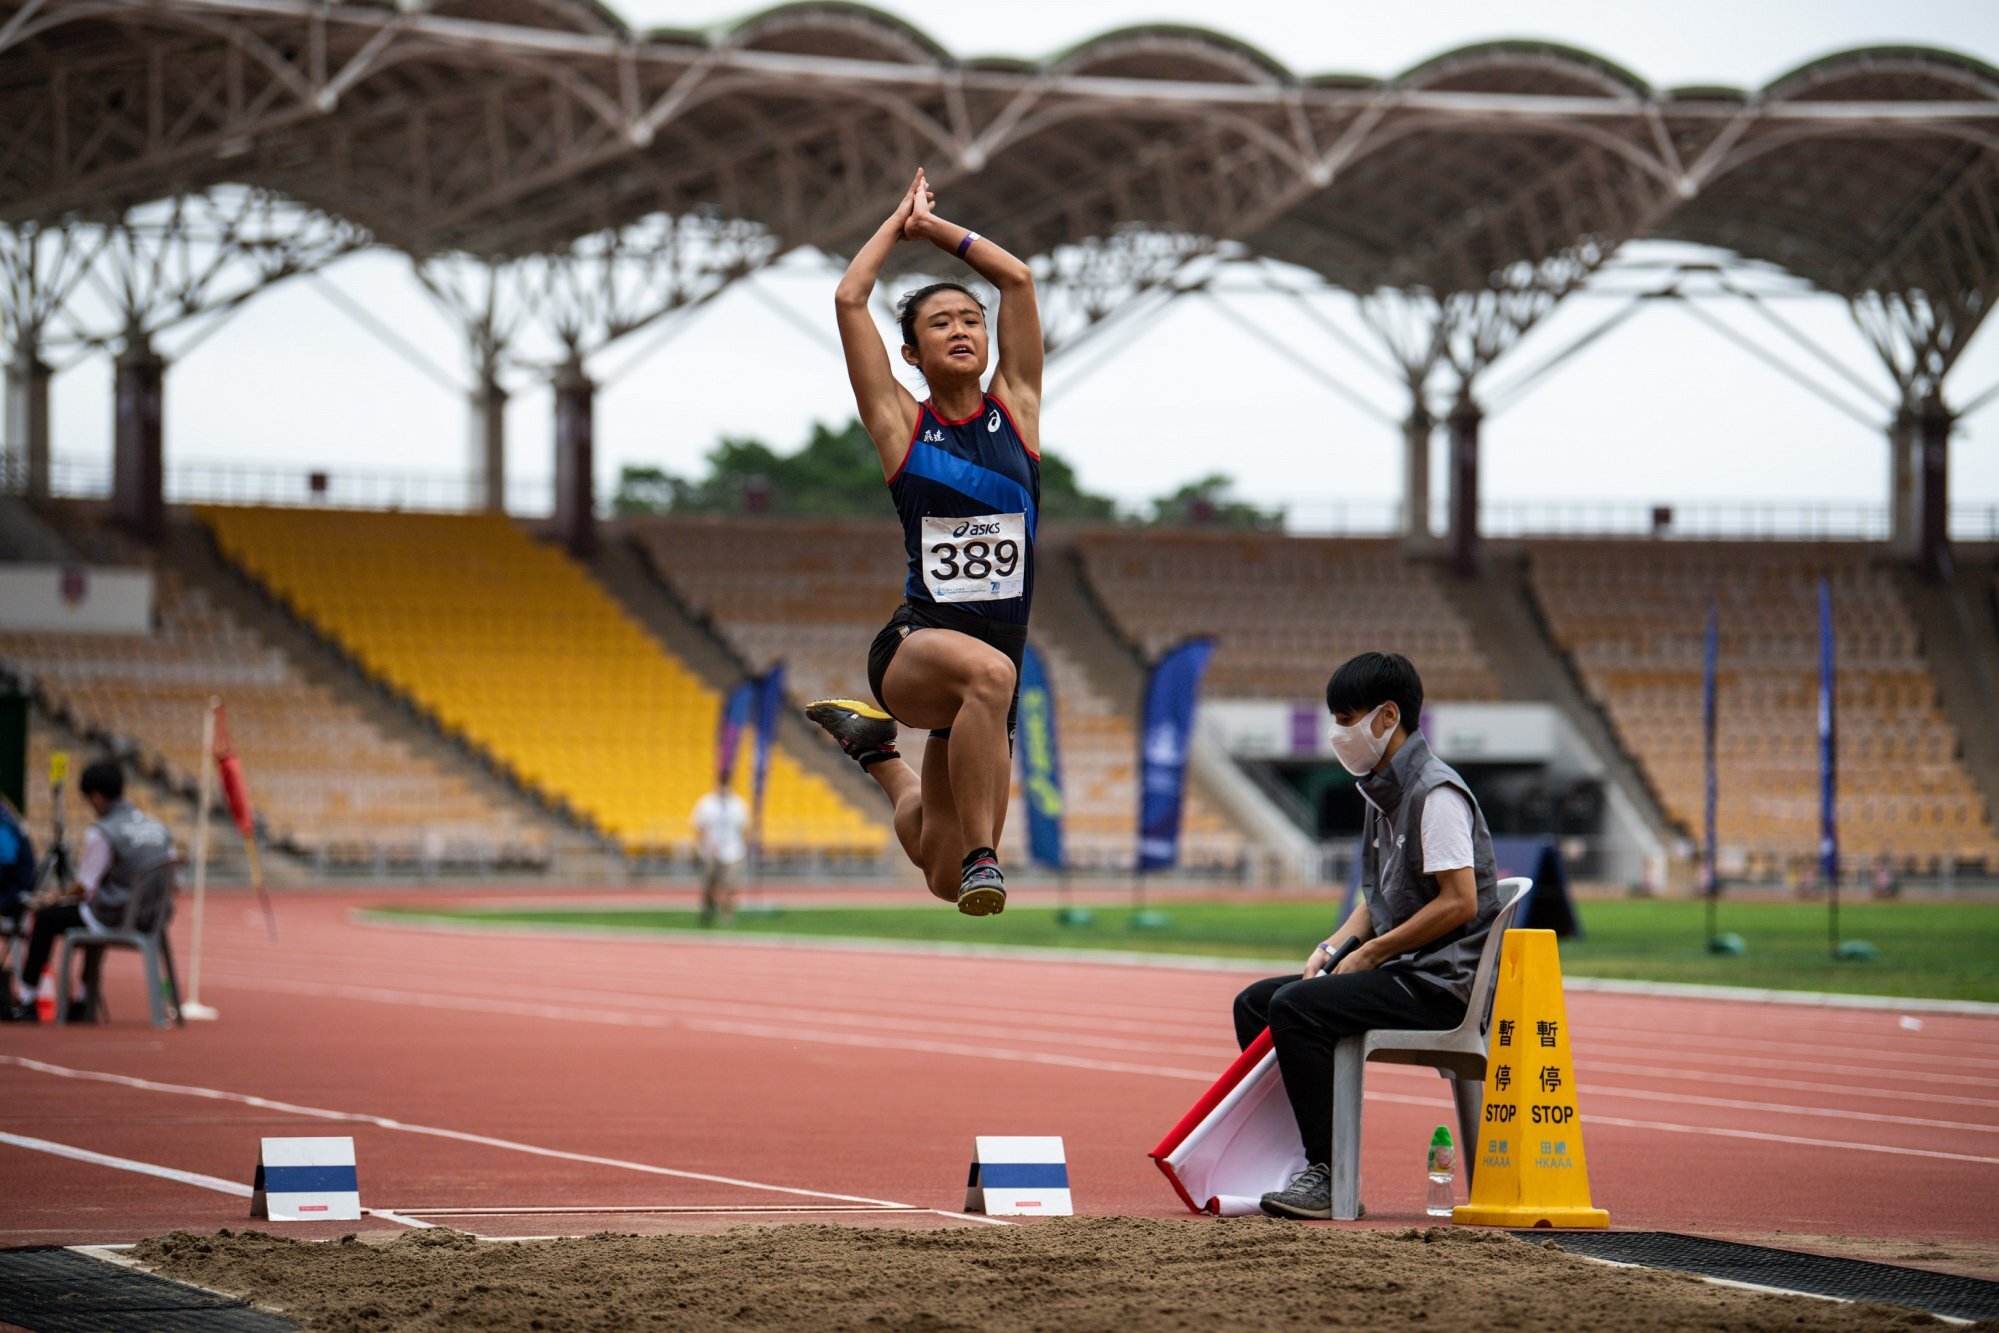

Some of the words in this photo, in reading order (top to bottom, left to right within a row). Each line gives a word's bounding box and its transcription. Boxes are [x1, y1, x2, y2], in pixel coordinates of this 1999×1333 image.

[970, 522, 1001, 535] asics
[930, 539, 1019, 580] 389
[1495, 1020, 1515, 1092] 暫停
[1536, 1021, 1562, 1092] 暫停
[1486, 1104, 1516, 1122] STOP
[1532, 1105, 1573, 1124] STOP
[1483, 1156, 1510, 1168] HKAAA
[1535, 1158, 1573, 1169] HKAAA
